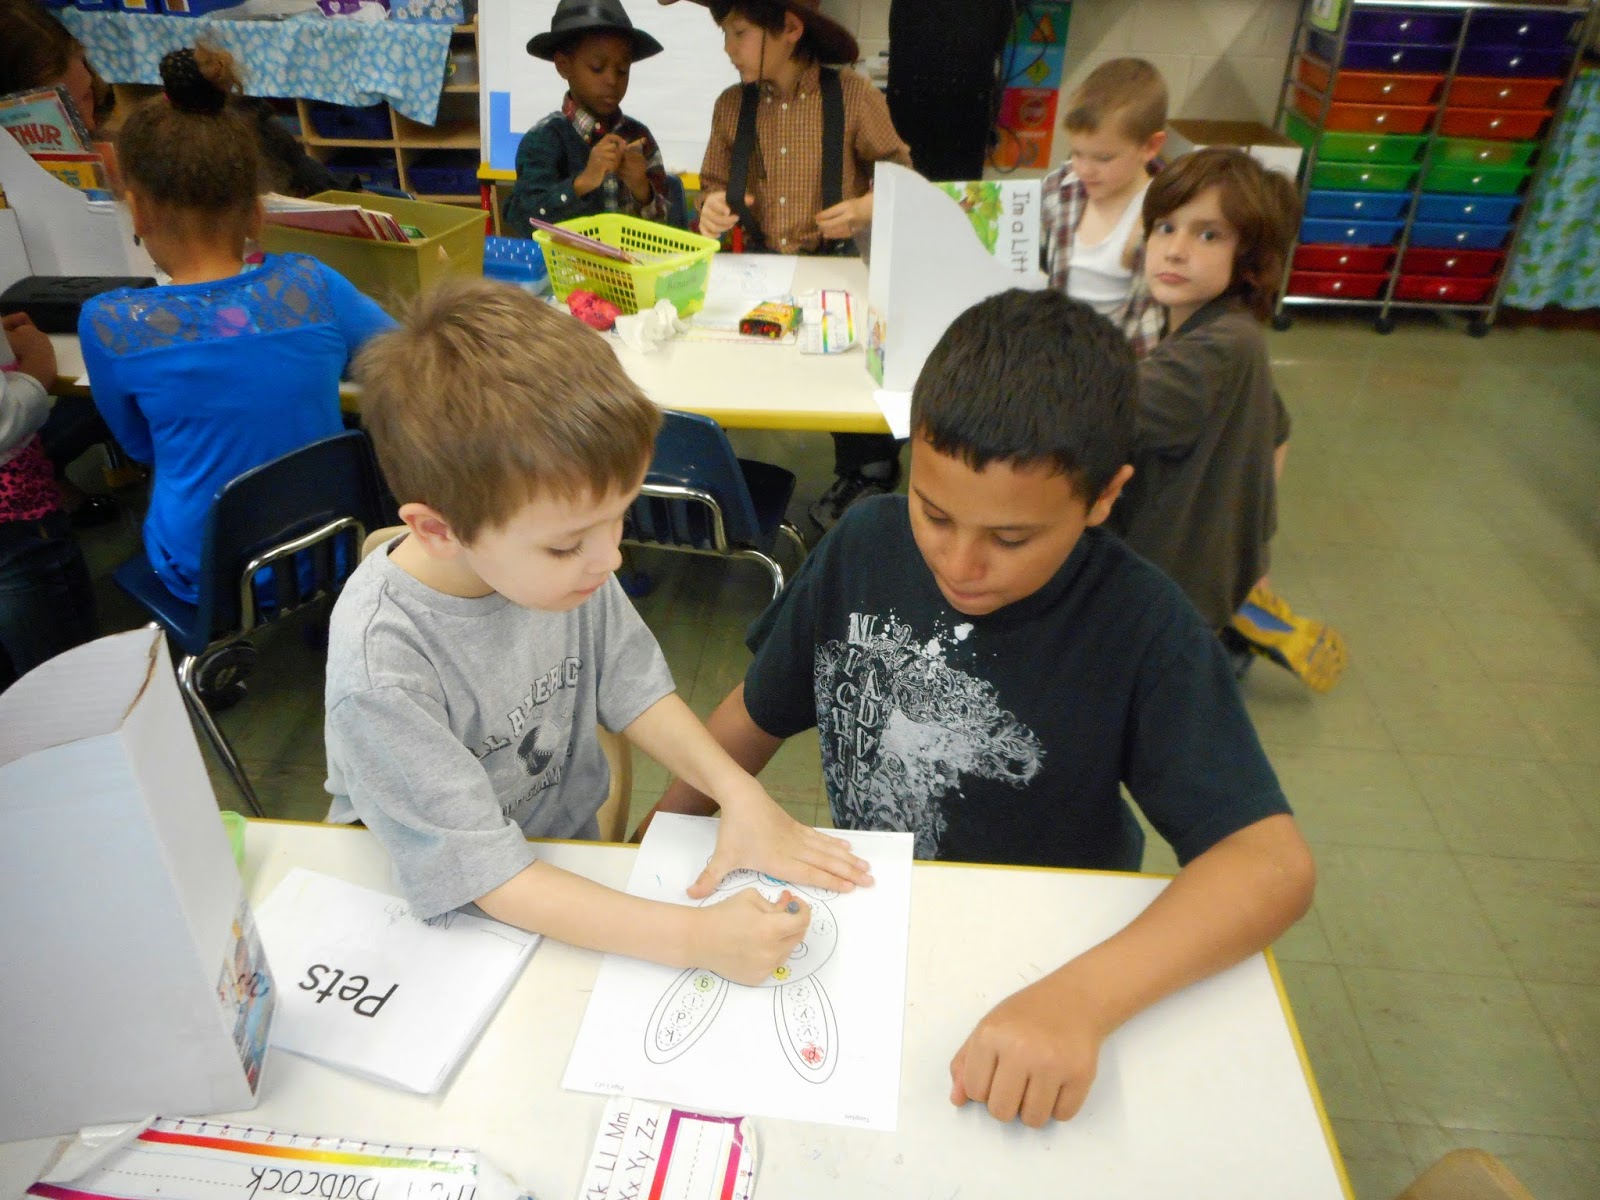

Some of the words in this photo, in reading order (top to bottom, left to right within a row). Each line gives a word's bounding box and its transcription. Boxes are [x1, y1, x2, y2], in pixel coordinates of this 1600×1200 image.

[1012, 220, 1024, 233] a
[298, 963, 399, 1018] Pets
[604, 1111, 630, 1140] Mm
[635, 1117, 659, 1140] Zz
[625, 1150, 655, 1171] Yy
